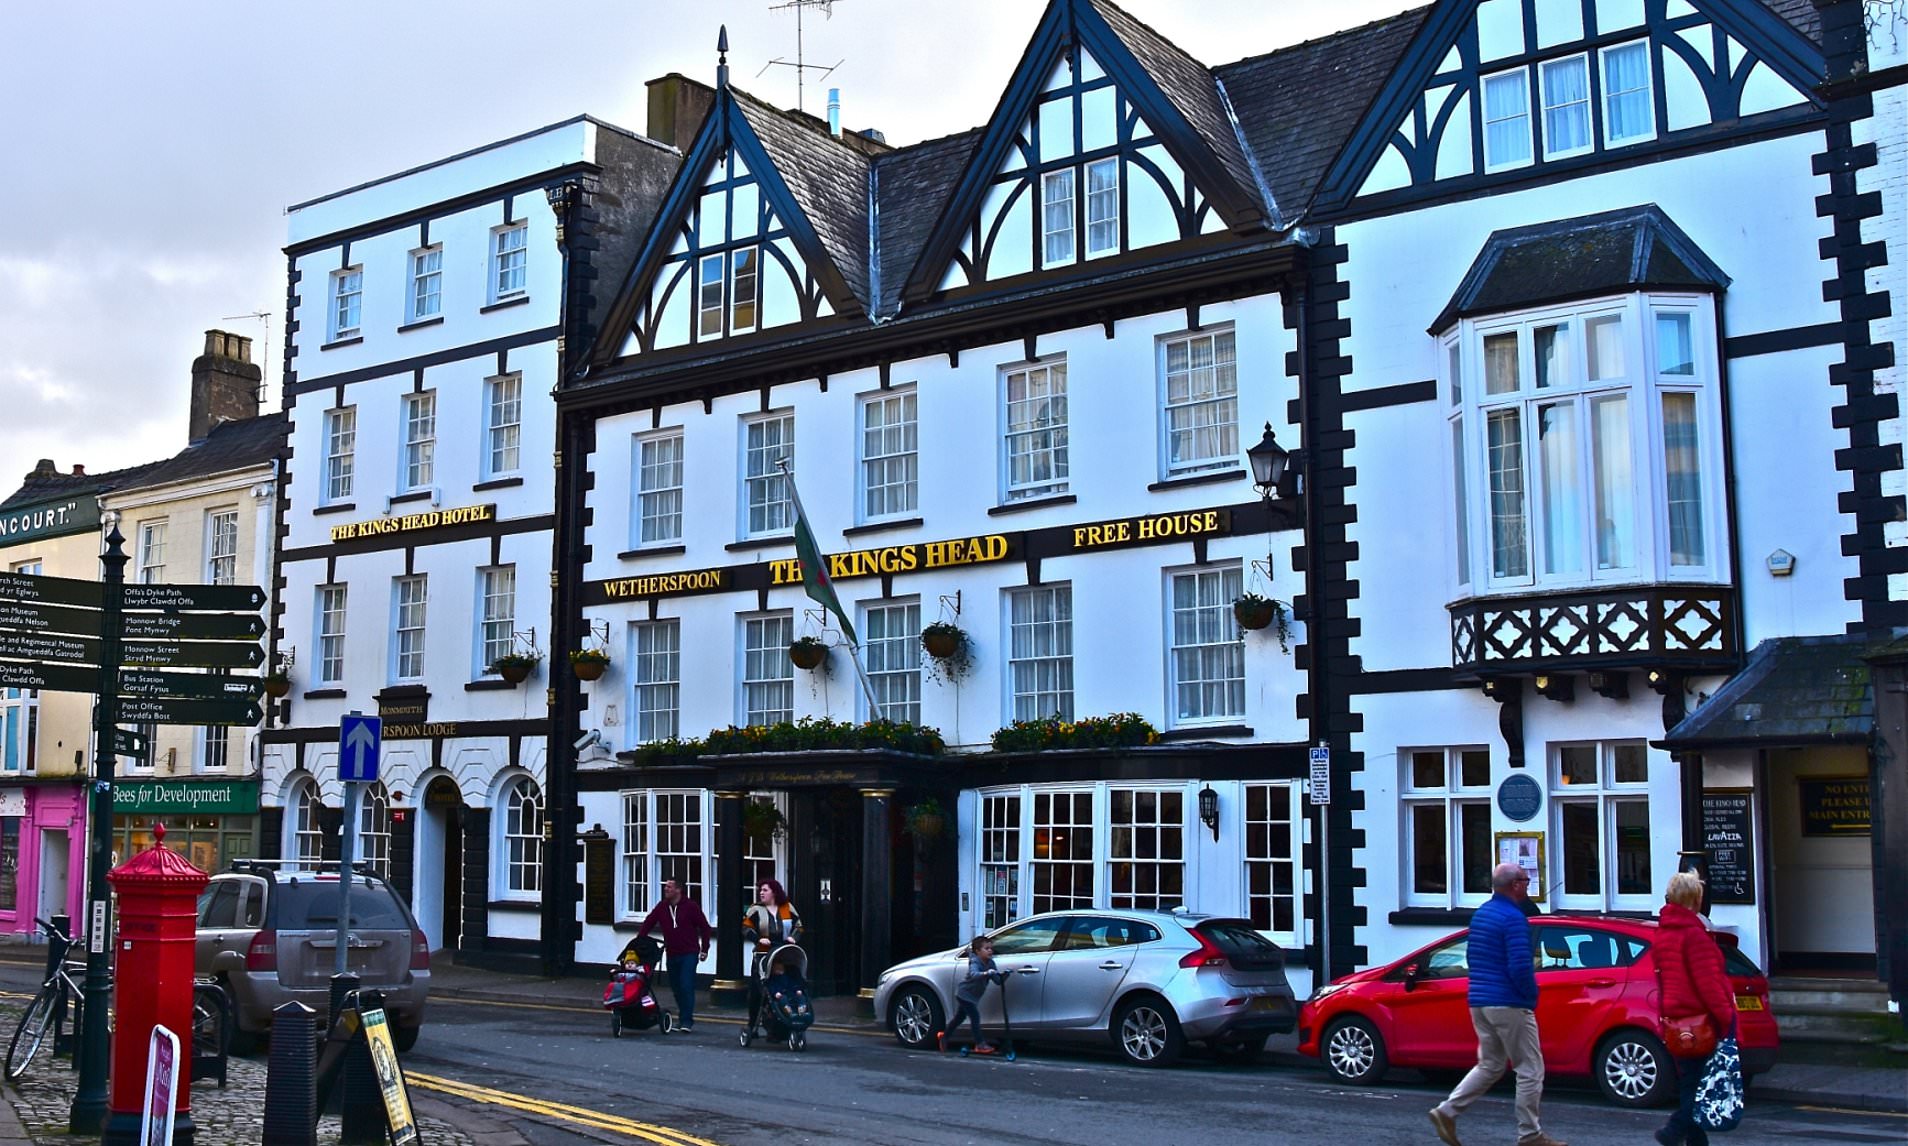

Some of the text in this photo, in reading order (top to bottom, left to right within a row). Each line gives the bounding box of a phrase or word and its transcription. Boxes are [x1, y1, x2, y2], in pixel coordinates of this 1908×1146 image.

[330, 505, 490, 540] THE KINGS HEAD HOTEL
[1073, 511, 1218, 547] FREE HOUSE
[769, 534, 1008, 585] TH KINGS HEAD
[603, 570, 721, 597] WETHERSPOON
[146, 588, 165, 597] Dyke
[166, 588, 182, 596] Path
[150, 597, 176, 605] Clawdd
[177, 597, 194, 606] Offa
[10, 607, 38, 616] Museum
[25, 617, 48, 626] Nelson
[125, 617, 181, 627] Monnow Bridge
[58, 640, 85, 650] Museum
[124, 646, 180, 654] Monnow Street
[18, 666, 35, 675] Path
[2, 674, 45, 686] Clawdd Offa
[123, 674, 165, 684] Bus Station
[121, 702, 164, 712] Post Office
[121, 711, 171, 721] Swyddfa Bost
[383, 723, 457, 737] RSPOON LODGE
[113, 784, 231, 809] Bees for Development
